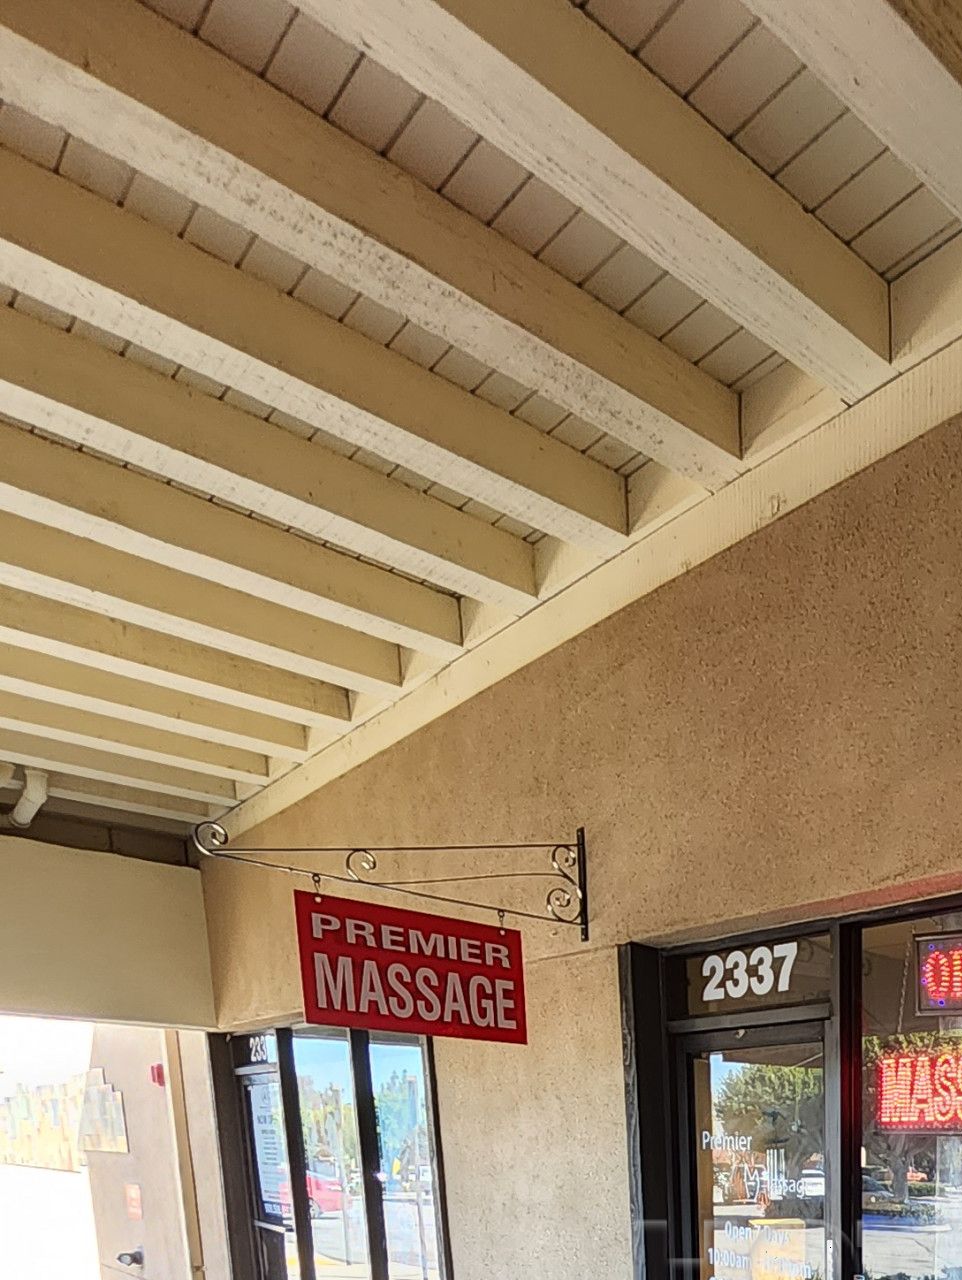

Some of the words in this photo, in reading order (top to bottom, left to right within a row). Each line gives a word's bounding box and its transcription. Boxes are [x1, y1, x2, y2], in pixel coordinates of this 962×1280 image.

[310, 912, 511, 969] PREMIER
[314, 952, 517, 1030] MASSAGE
[702, 942, 798, 1001] 2337
[702, 1130, 753, 1151] Premier
[725, 1220, 752, 1242] Open
[708, 1247, 752, 1271] 10:00am
